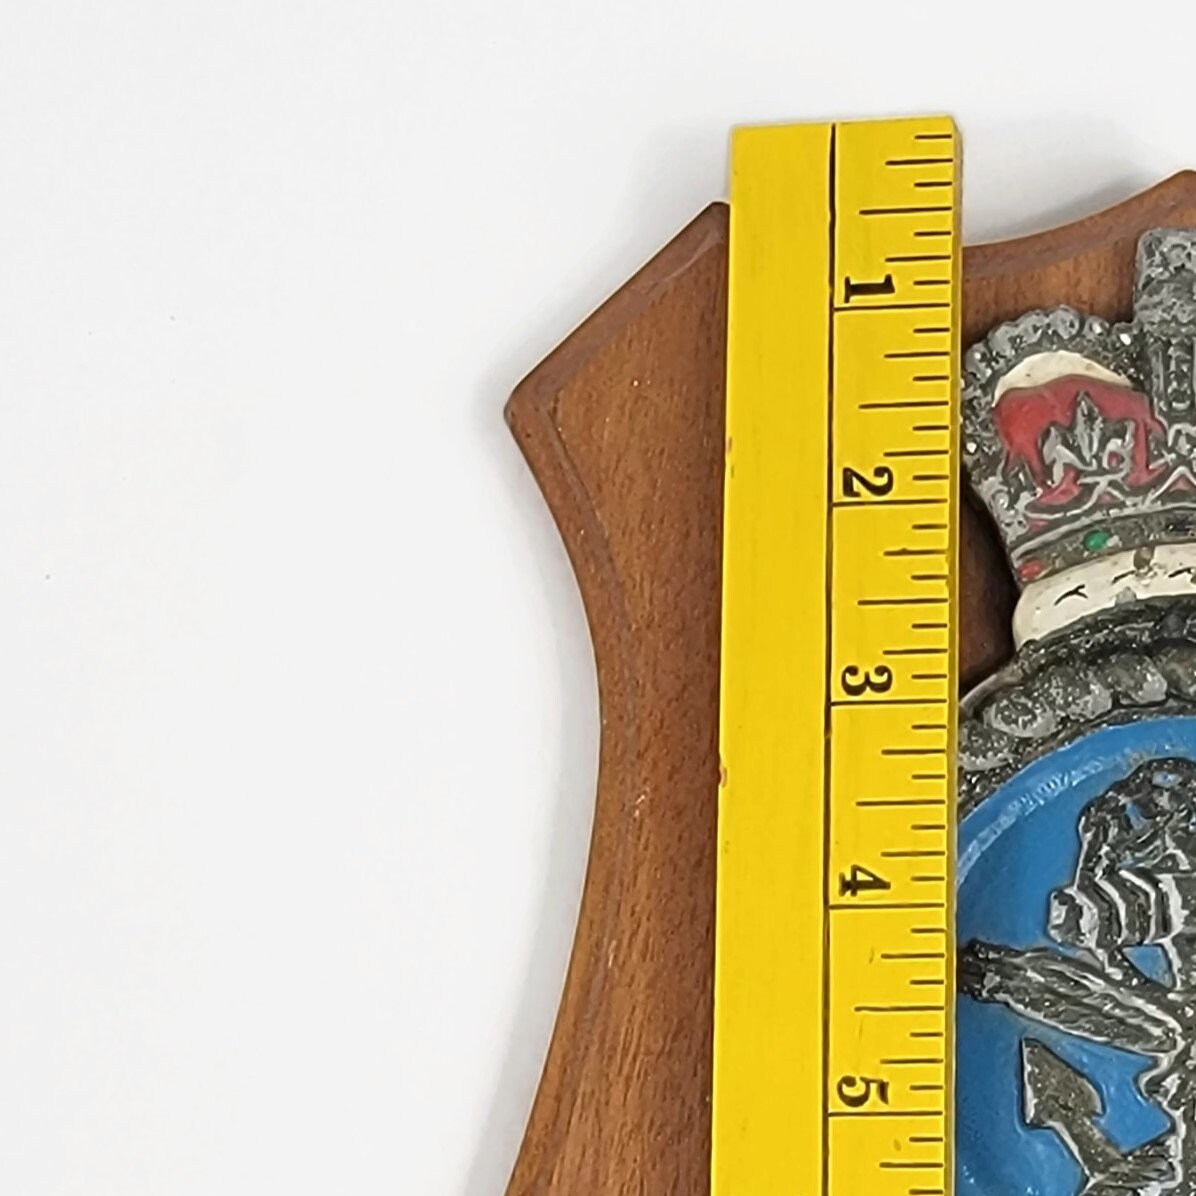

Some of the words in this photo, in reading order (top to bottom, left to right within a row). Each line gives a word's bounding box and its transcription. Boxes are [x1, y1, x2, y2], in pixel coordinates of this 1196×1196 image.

[843, 274, 895, 303] 1
[842, 465, 894, 498] 2
[841, 664, 893, 697] 3
[838, 864, 891, 897] 4
[836, 1075, 889, 1107] 5
